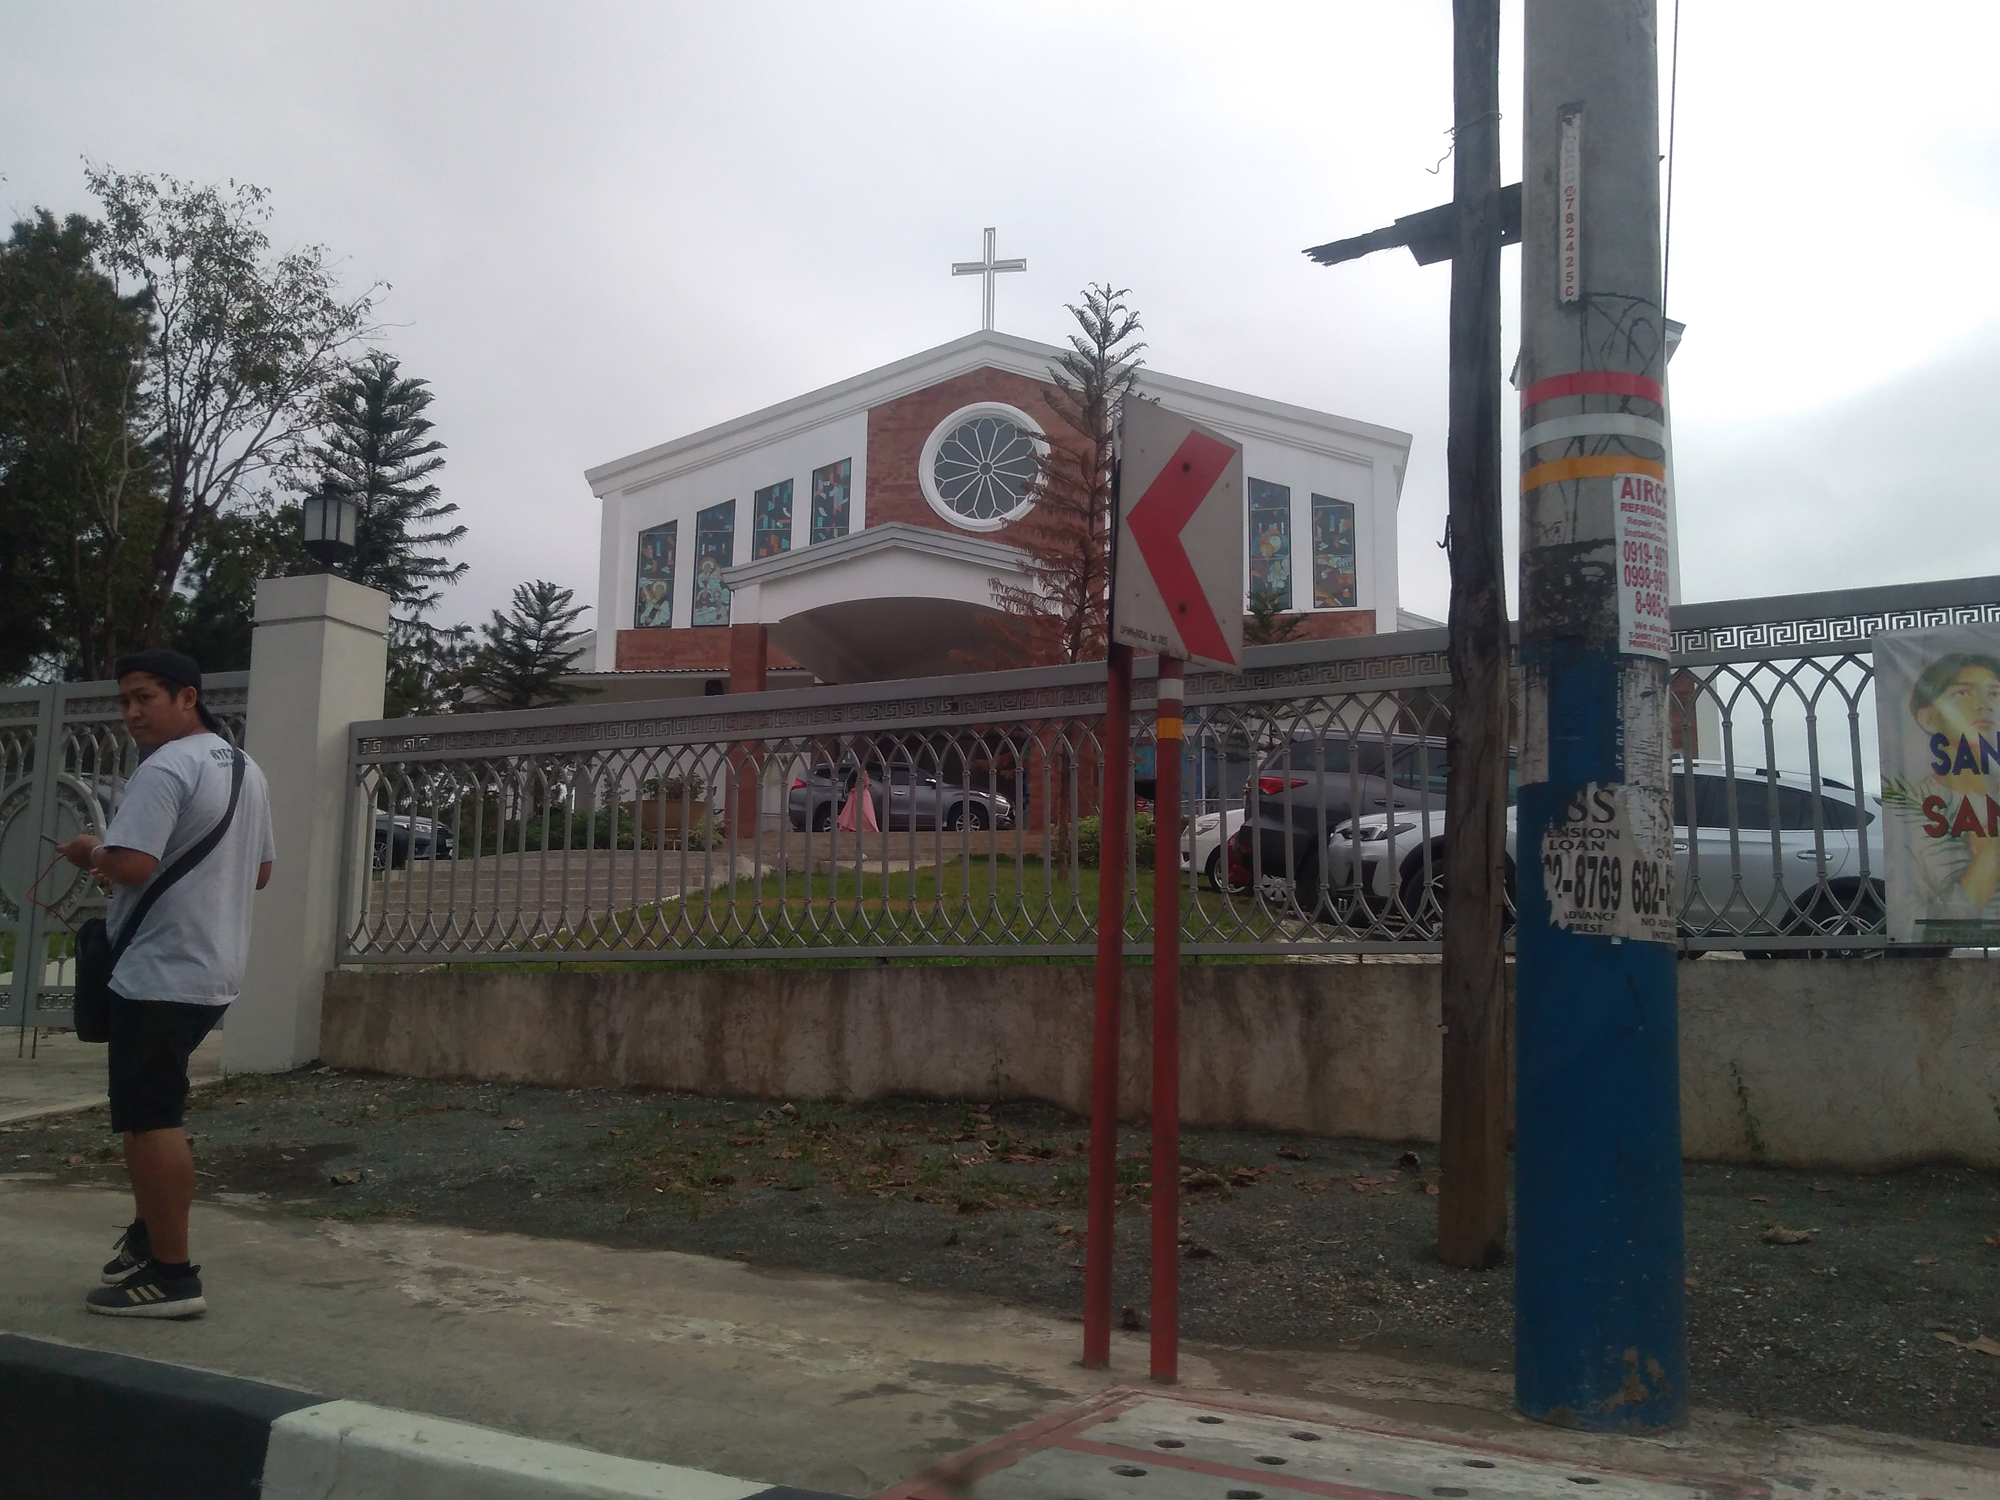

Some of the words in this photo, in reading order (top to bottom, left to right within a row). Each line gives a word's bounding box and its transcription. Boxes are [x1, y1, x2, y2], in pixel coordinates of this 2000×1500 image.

[1546, 827, 1620, 840] ENSION
[1548, 839, 1606, 852] LOAN
[1641, 917, 1655, 927] NO
